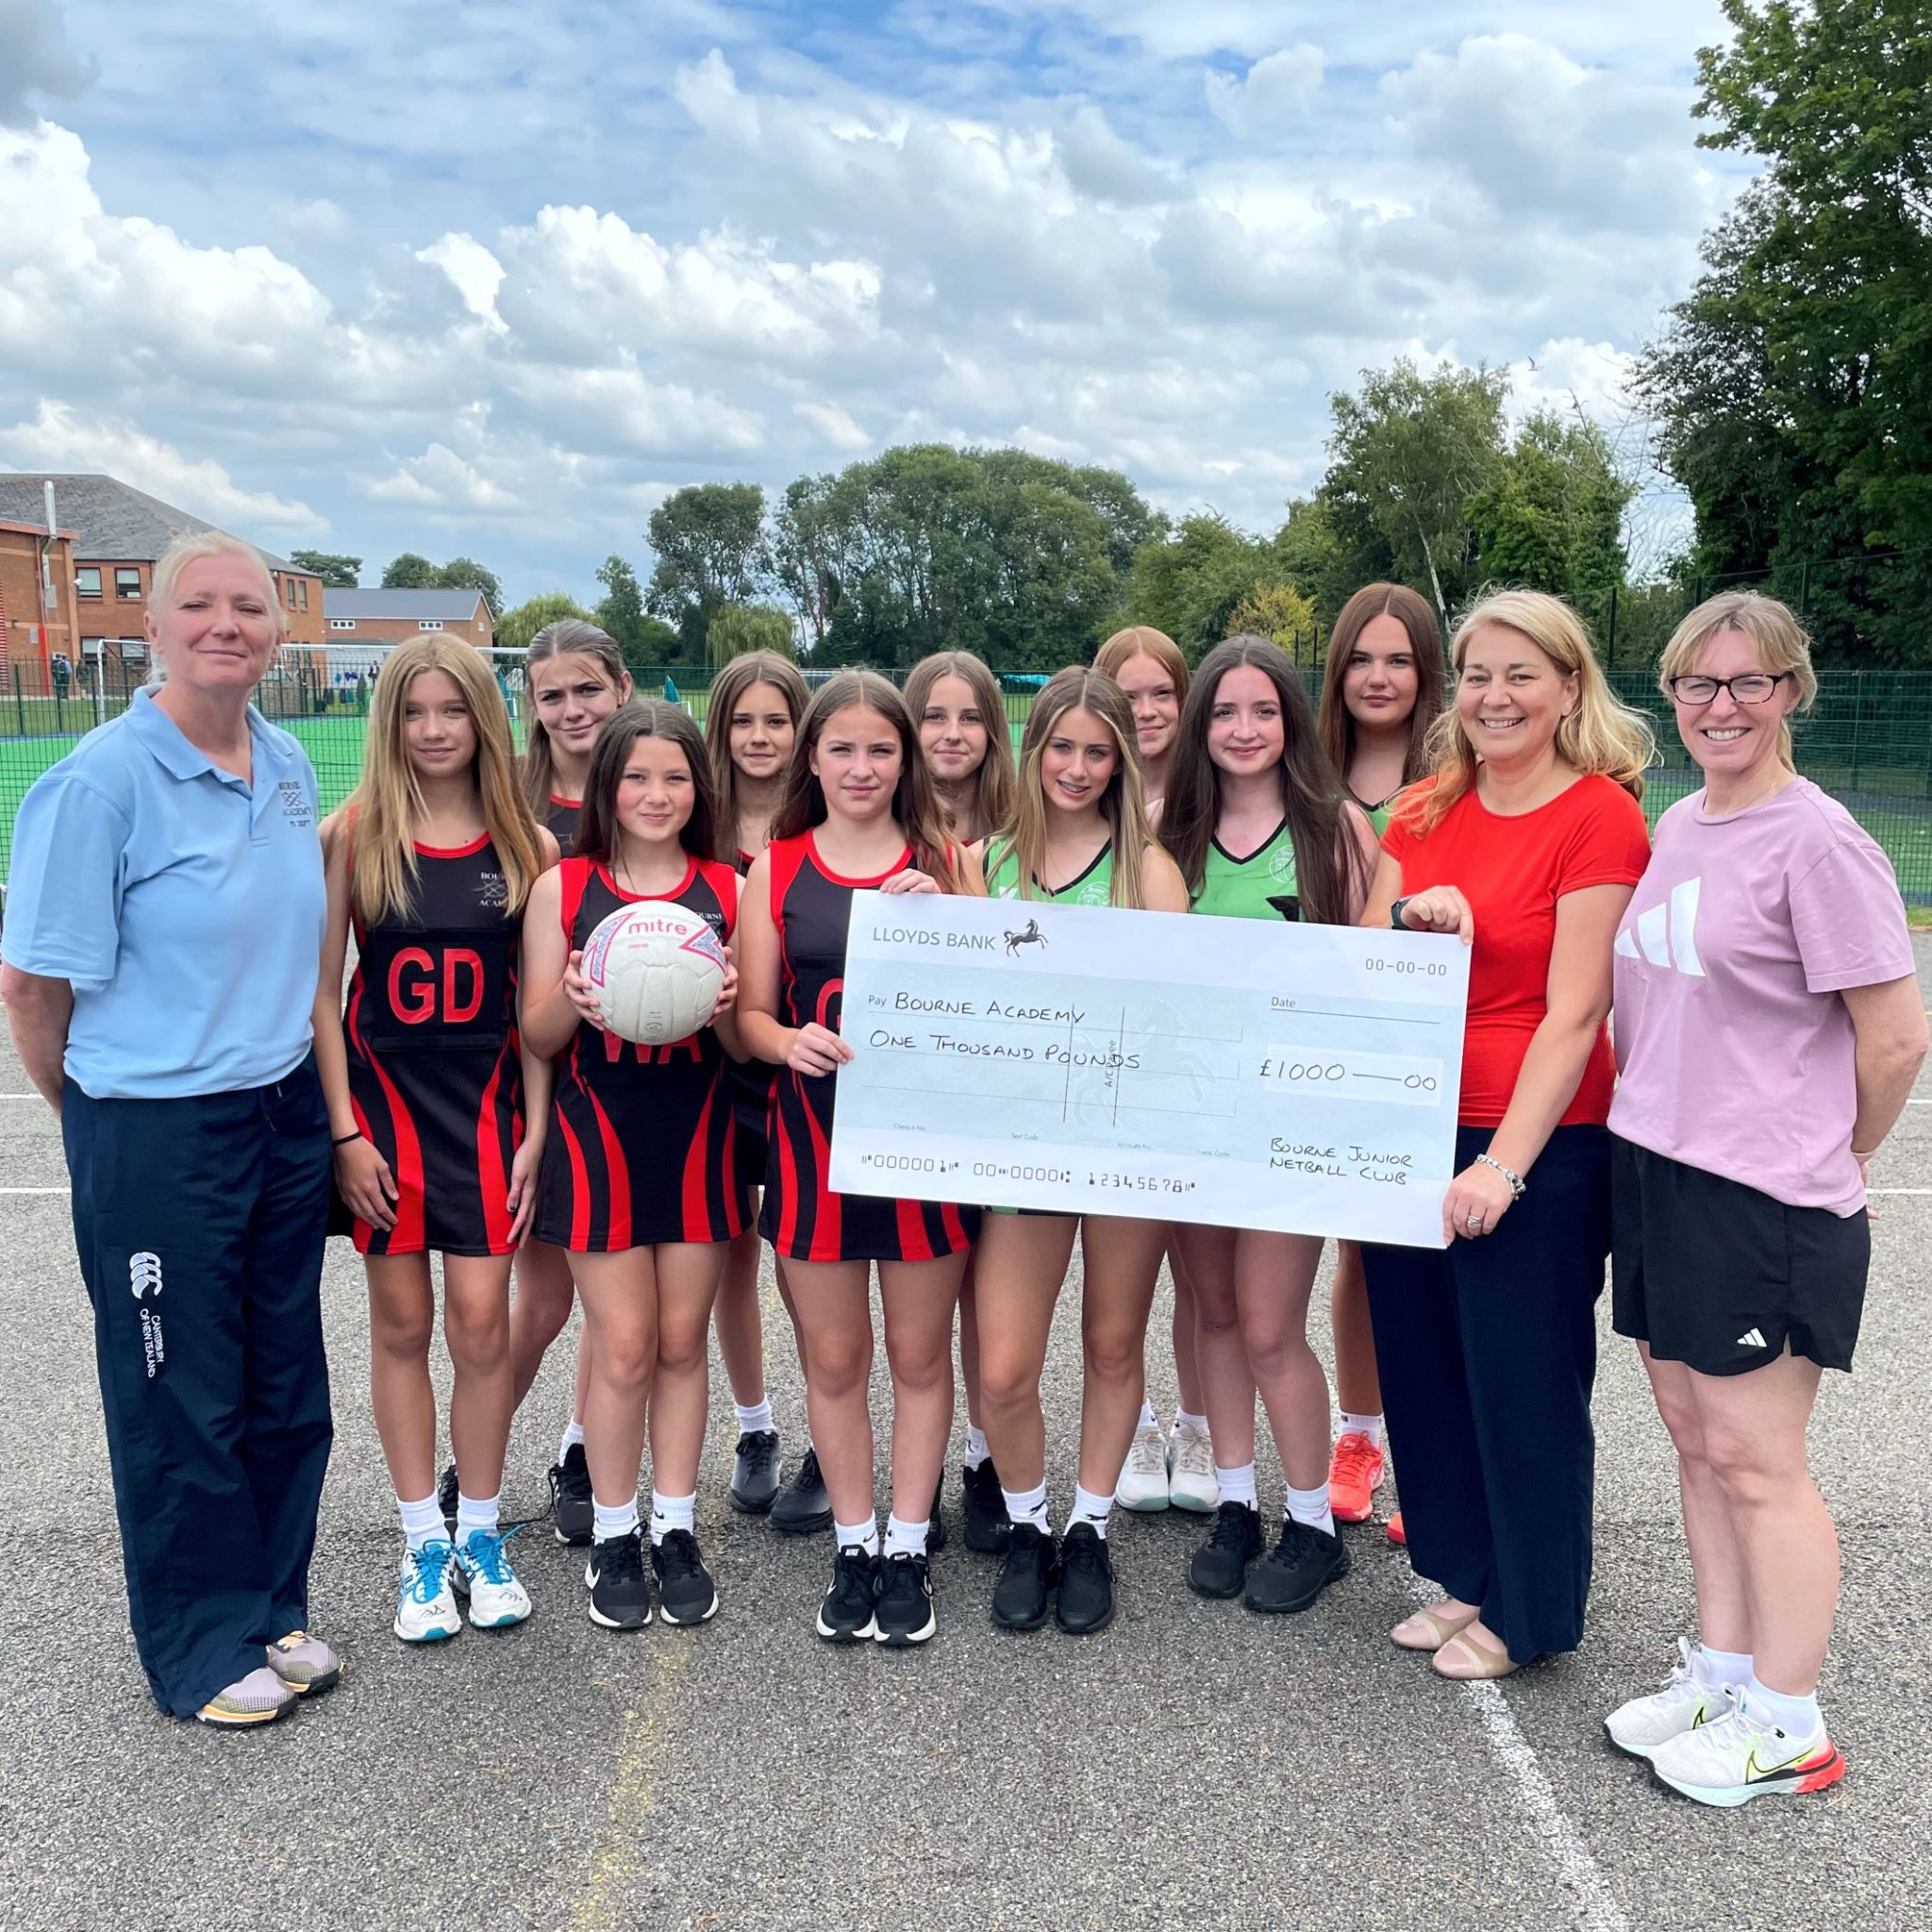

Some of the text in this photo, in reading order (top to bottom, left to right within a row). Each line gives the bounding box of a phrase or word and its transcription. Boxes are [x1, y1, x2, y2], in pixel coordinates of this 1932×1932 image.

[628, 919, 688, 936] mitre
[873, 927, 996, 950] LLOYDS BANK
[1365, 958, 1448, 976] 00-00-00
[388, 946, 485, 1024] GD
[868, 994, 887, 1008] Pay
[895, 991, 1086, 1024] BOURNE ACADEMY
[1271, 997, 1296, 1008] Date
[870, 1030, 1141, 1070] ONE THOUSAND POUNDS
[1270, 1137, 1414, 1168] BOURNE JUNIOR
[1270, 1157, 1407, 1186] NETBALL CLUB
[142, 1321, 153, 1341] NEW
[144, 1340, 156, 1378] ZEALAND
